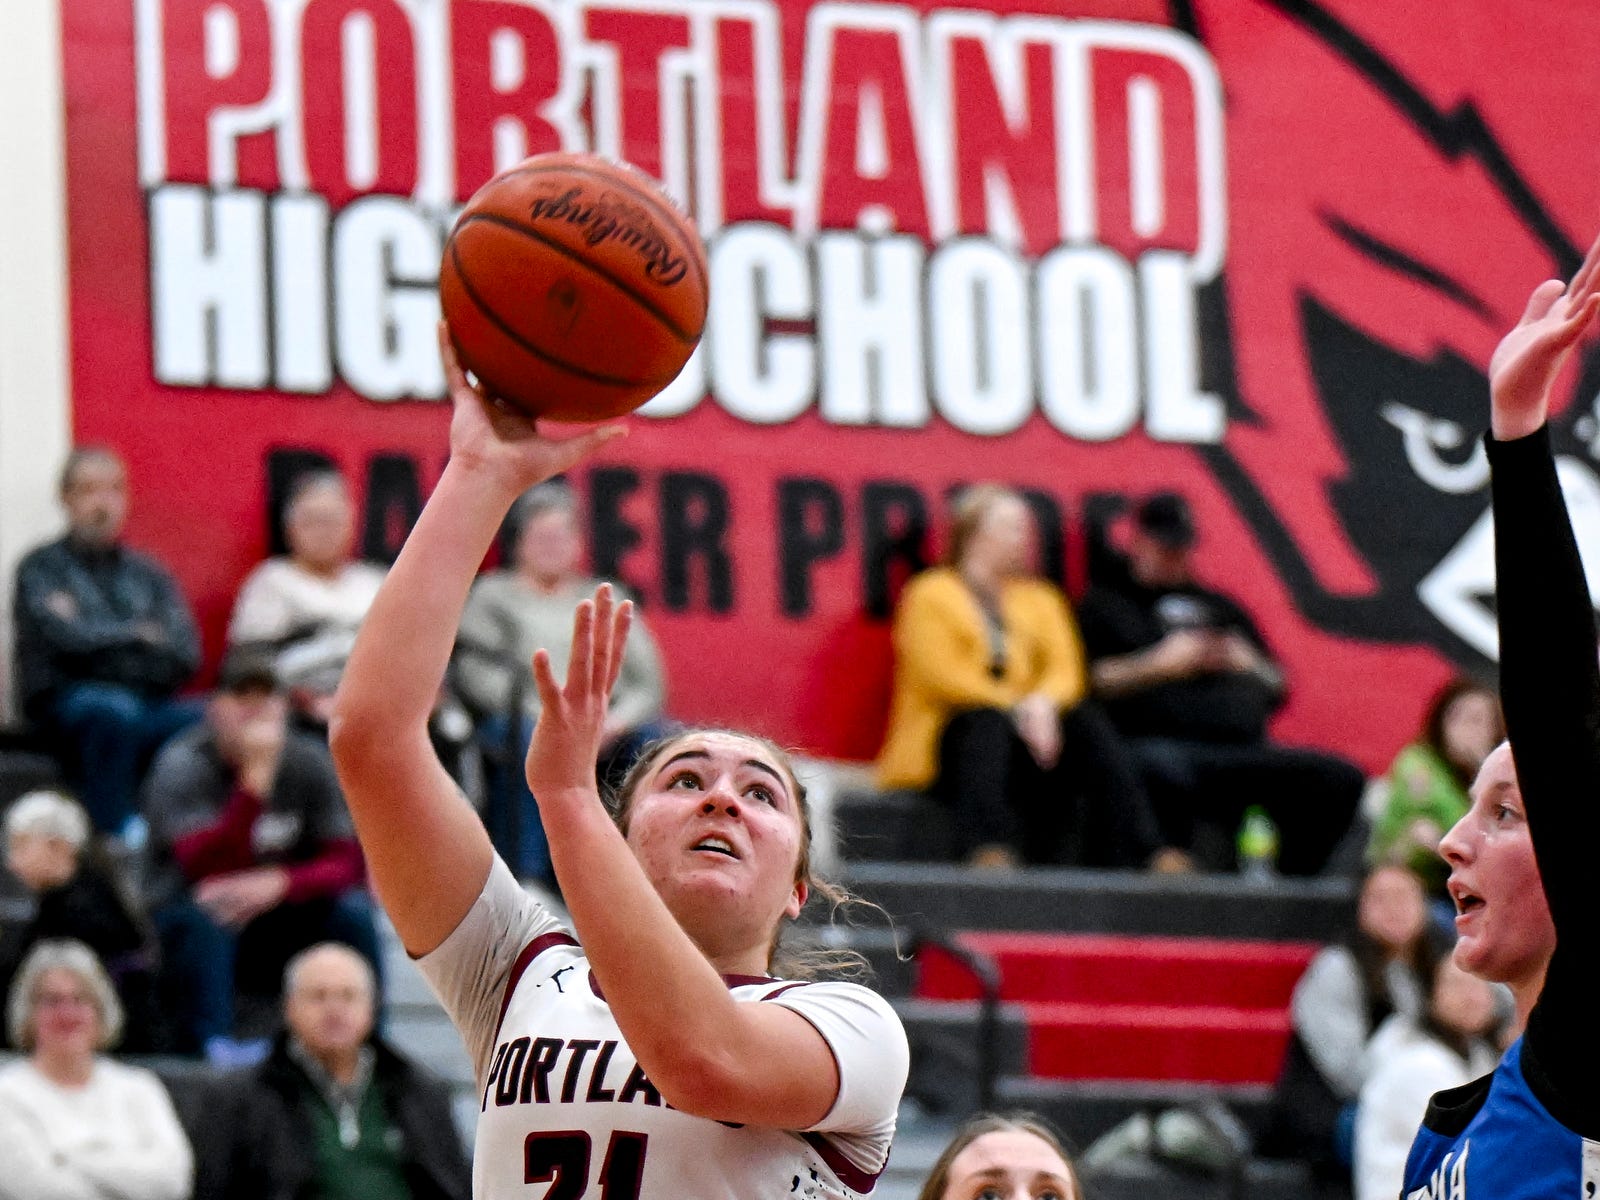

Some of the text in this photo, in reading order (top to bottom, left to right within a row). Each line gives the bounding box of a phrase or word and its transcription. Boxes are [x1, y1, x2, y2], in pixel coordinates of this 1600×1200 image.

[136, 0, 1227, 284] PORTLAND
[150, 184, 1227, 443] HIG CHOOL
[481, 1036, 745, 1128] PORTLA
